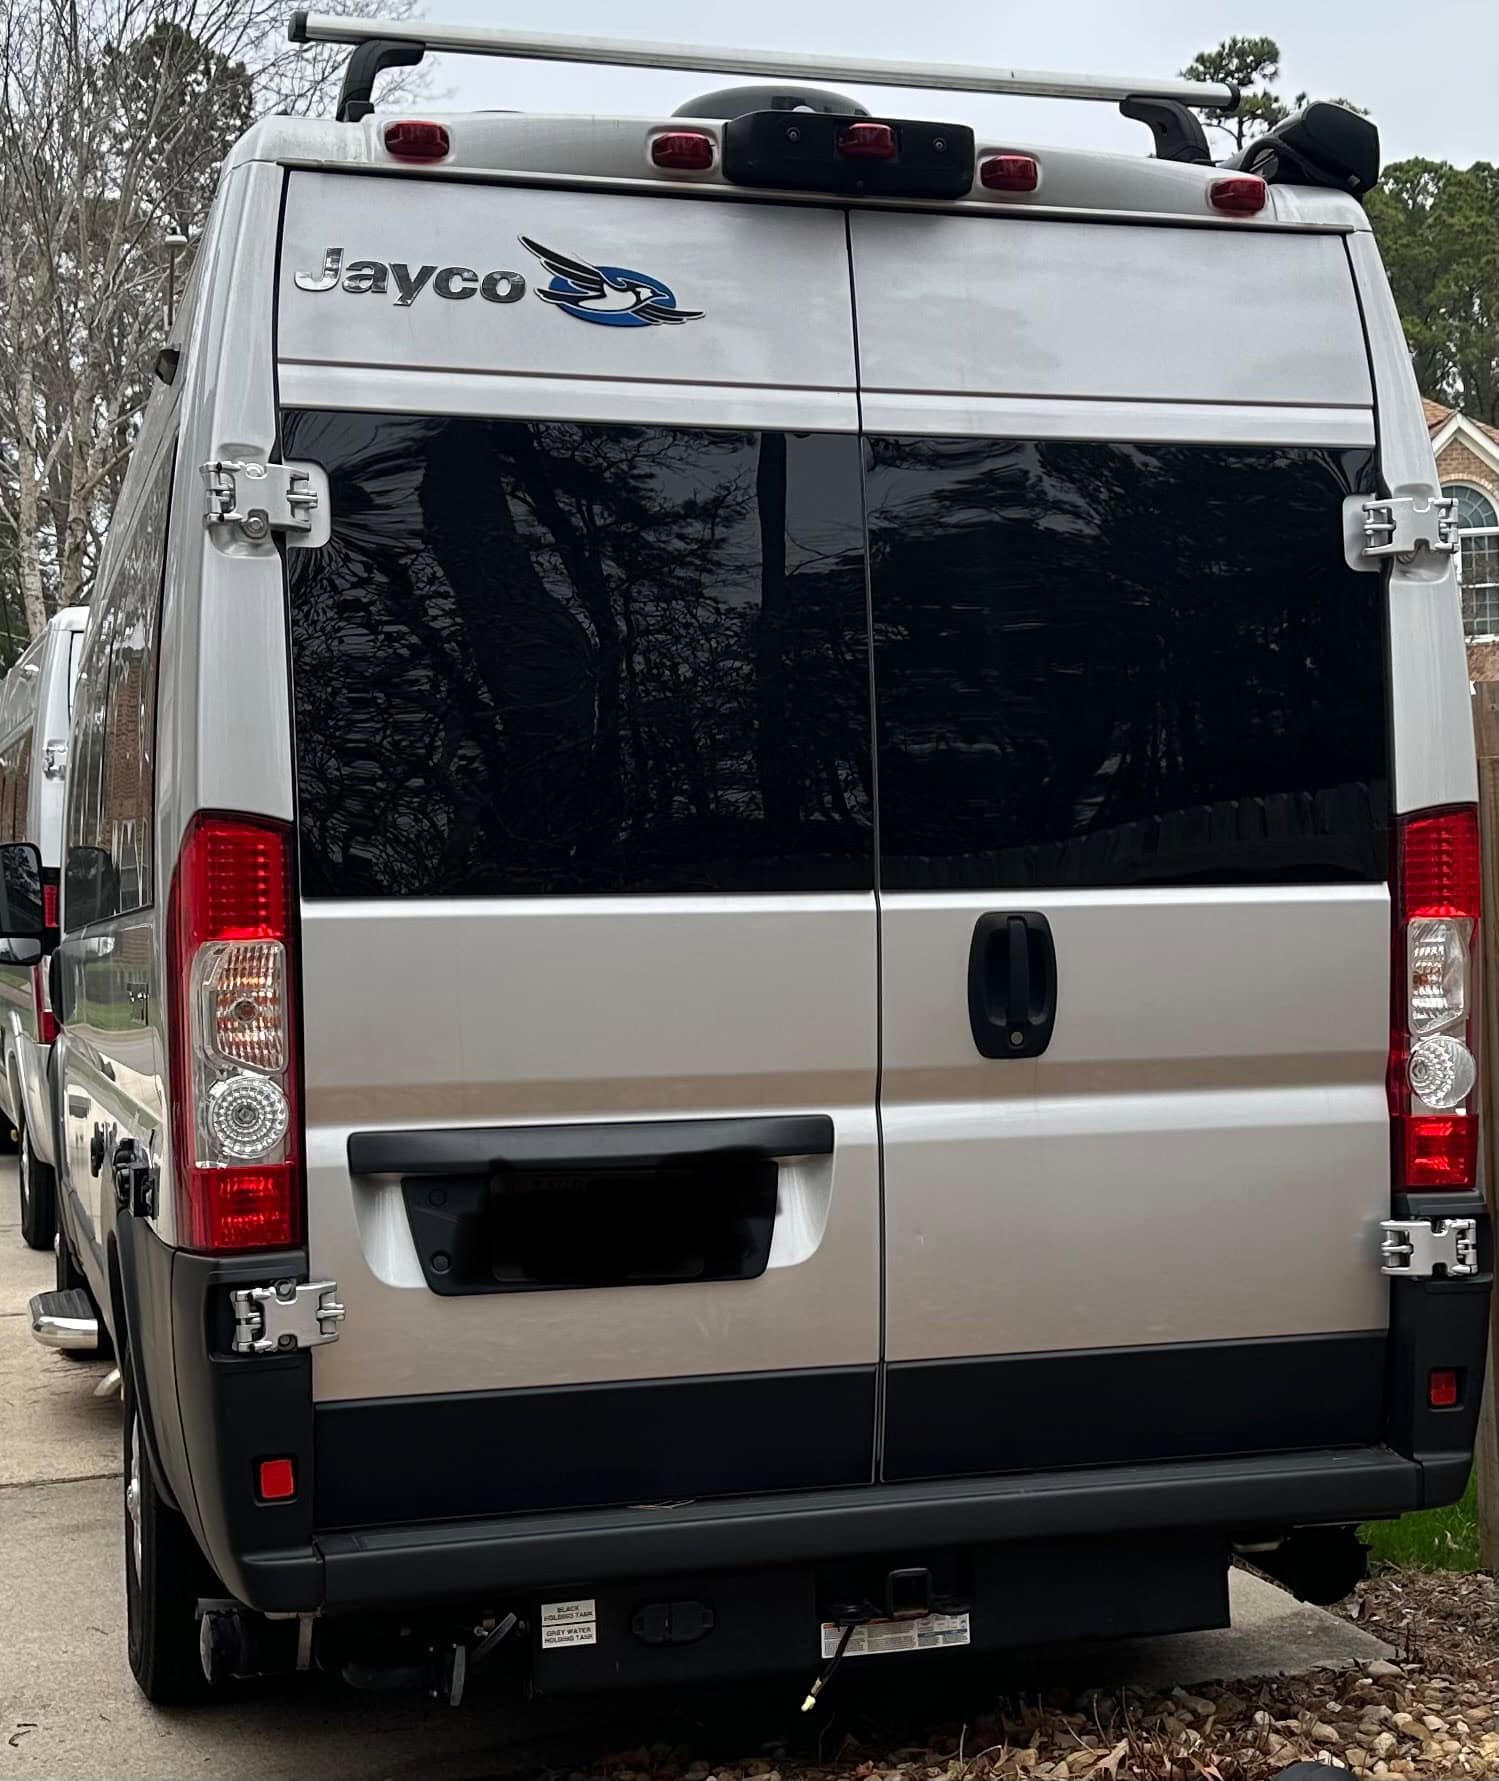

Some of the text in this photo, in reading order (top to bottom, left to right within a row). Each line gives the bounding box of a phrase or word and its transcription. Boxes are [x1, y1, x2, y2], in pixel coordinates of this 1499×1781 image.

[294, 247, 527, 307] Jayco
[557, 1605, 579, 1613] BLACK
[567, 1627, 592, 1635] WATER
